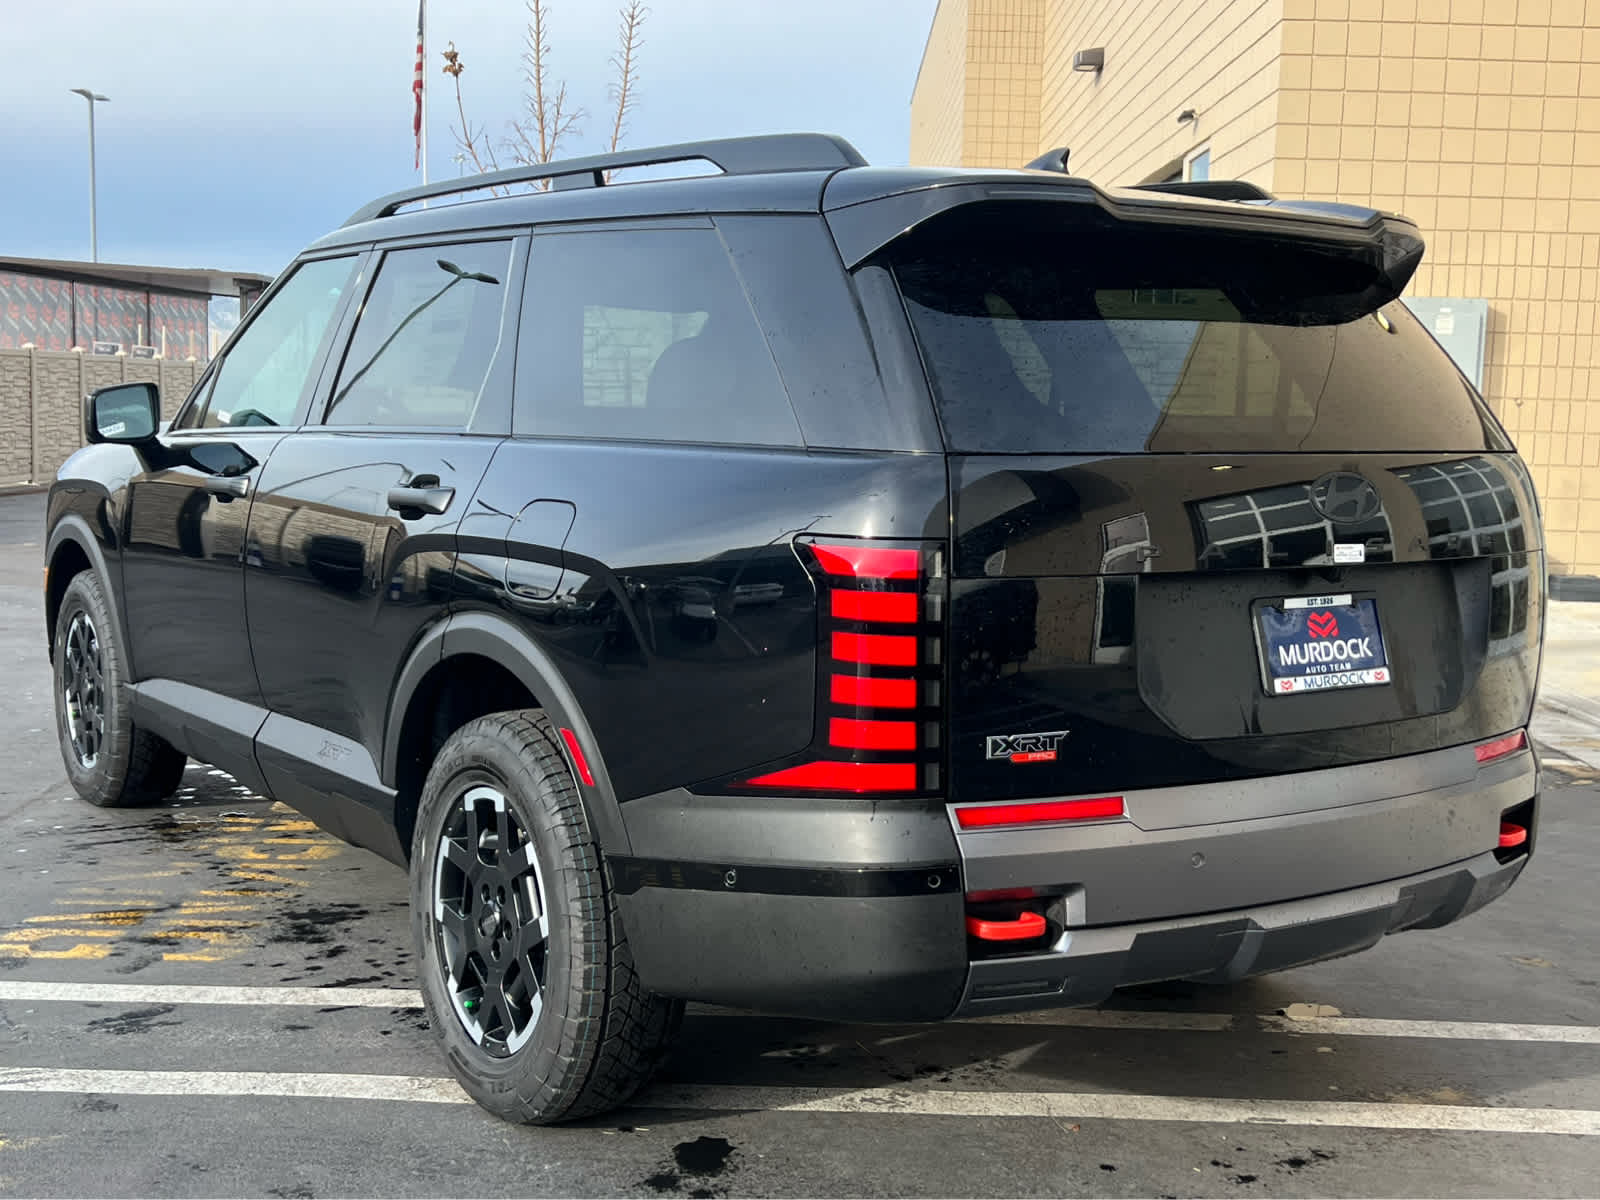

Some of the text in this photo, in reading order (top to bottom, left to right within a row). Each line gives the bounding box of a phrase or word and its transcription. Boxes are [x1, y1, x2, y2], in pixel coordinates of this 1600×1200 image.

[1279, 637, 1373, 667] MURDOCK
[1305, 662, 1352, 674] AUTO TEAM
[1303, 672, 1366, 689] MURDOCK
[986, 730, 1070, 760] XRT
